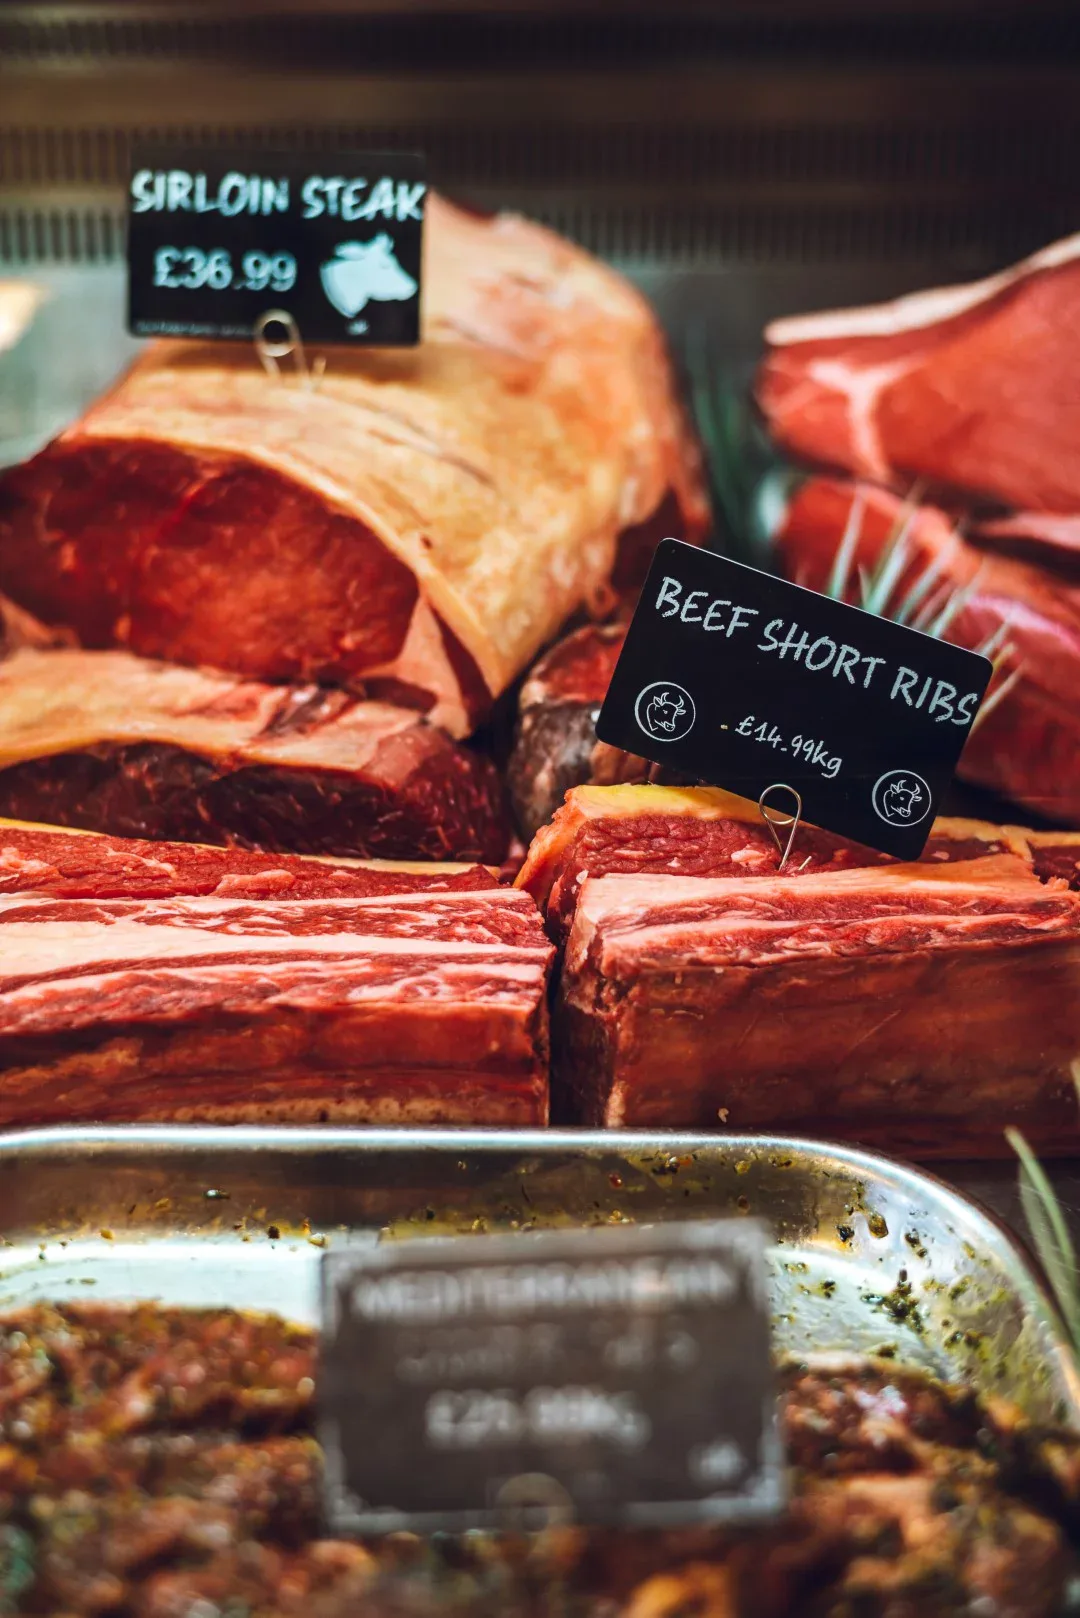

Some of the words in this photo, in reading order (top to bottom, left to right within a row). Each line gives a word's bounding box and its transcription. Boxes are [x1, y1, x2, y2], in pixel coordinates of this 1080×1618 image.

[131, 171, 290, 216] SIRLOIN
[302, 177, 426, 222] STEAK
[153, 247, 298, 292] £36.99
[655, 576, 759, 638] BEEF
[757, 618, 887, 690] SHORT
[890, 666, 979, 726] RIBS
[734, 715, 844, 779] £14.99kg
